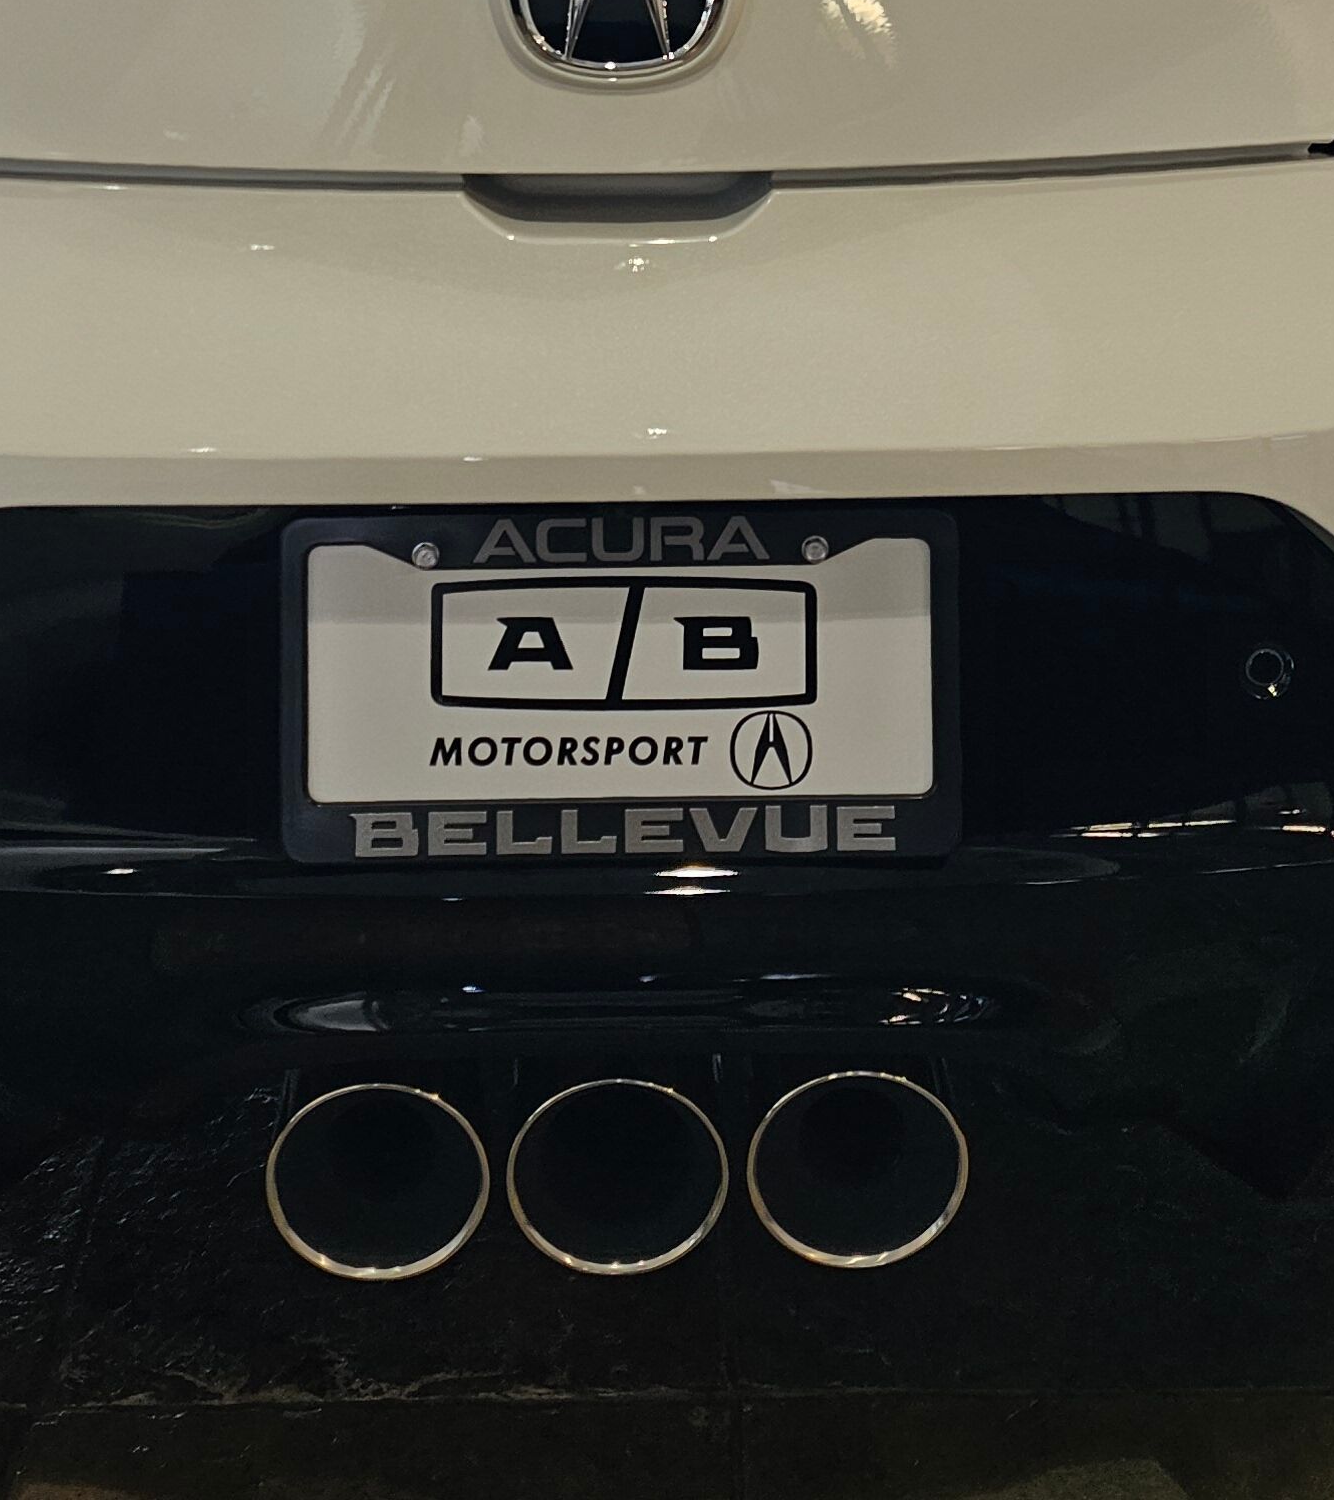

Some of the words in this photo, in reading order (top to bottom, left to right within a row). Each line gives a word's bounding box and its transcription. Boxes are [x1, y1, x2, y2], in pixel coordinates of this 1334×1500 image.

[473, 515, 770, 564] ACURA
[488, 616, 574, 671] A
[673, 616, 759, 670] B
[429, 736, 708, 767] MOTORSPORT
[349, 805, 896, 857] BELLEVUE
